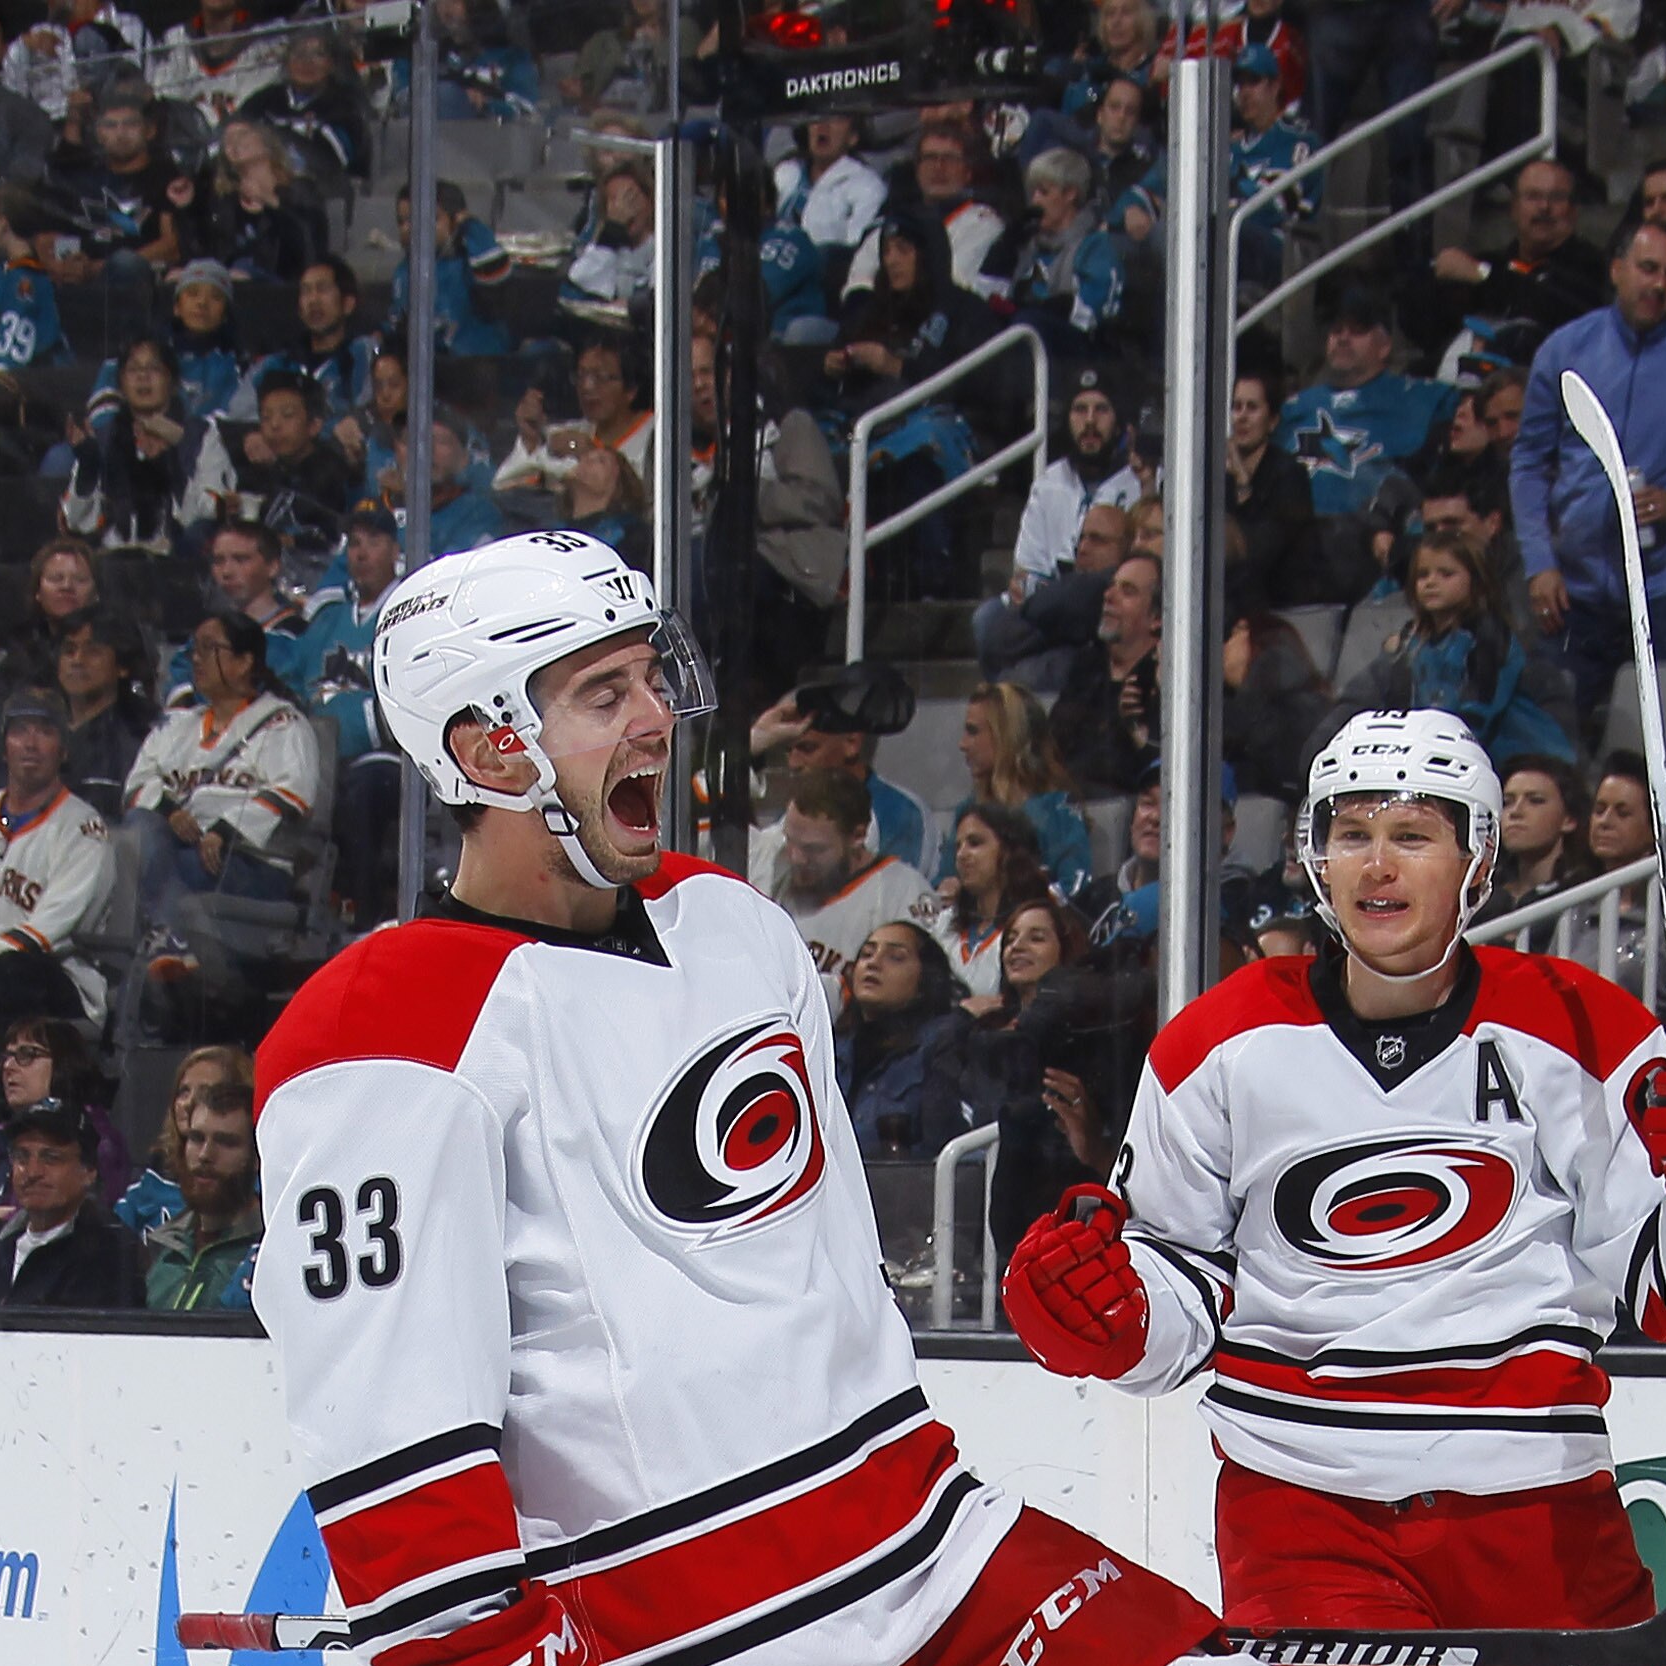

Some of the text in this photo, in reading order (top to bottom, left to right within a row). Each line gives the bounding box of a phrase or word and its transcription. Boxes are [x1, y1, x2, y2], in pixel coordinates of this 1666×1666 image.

[785, 61, 901, 99] DAKTRONICS
[1351, 743, 1413, 757] CCM
[1474, 1040, 1523, 1122] A
[296, 1175, 405, 1303] 33
